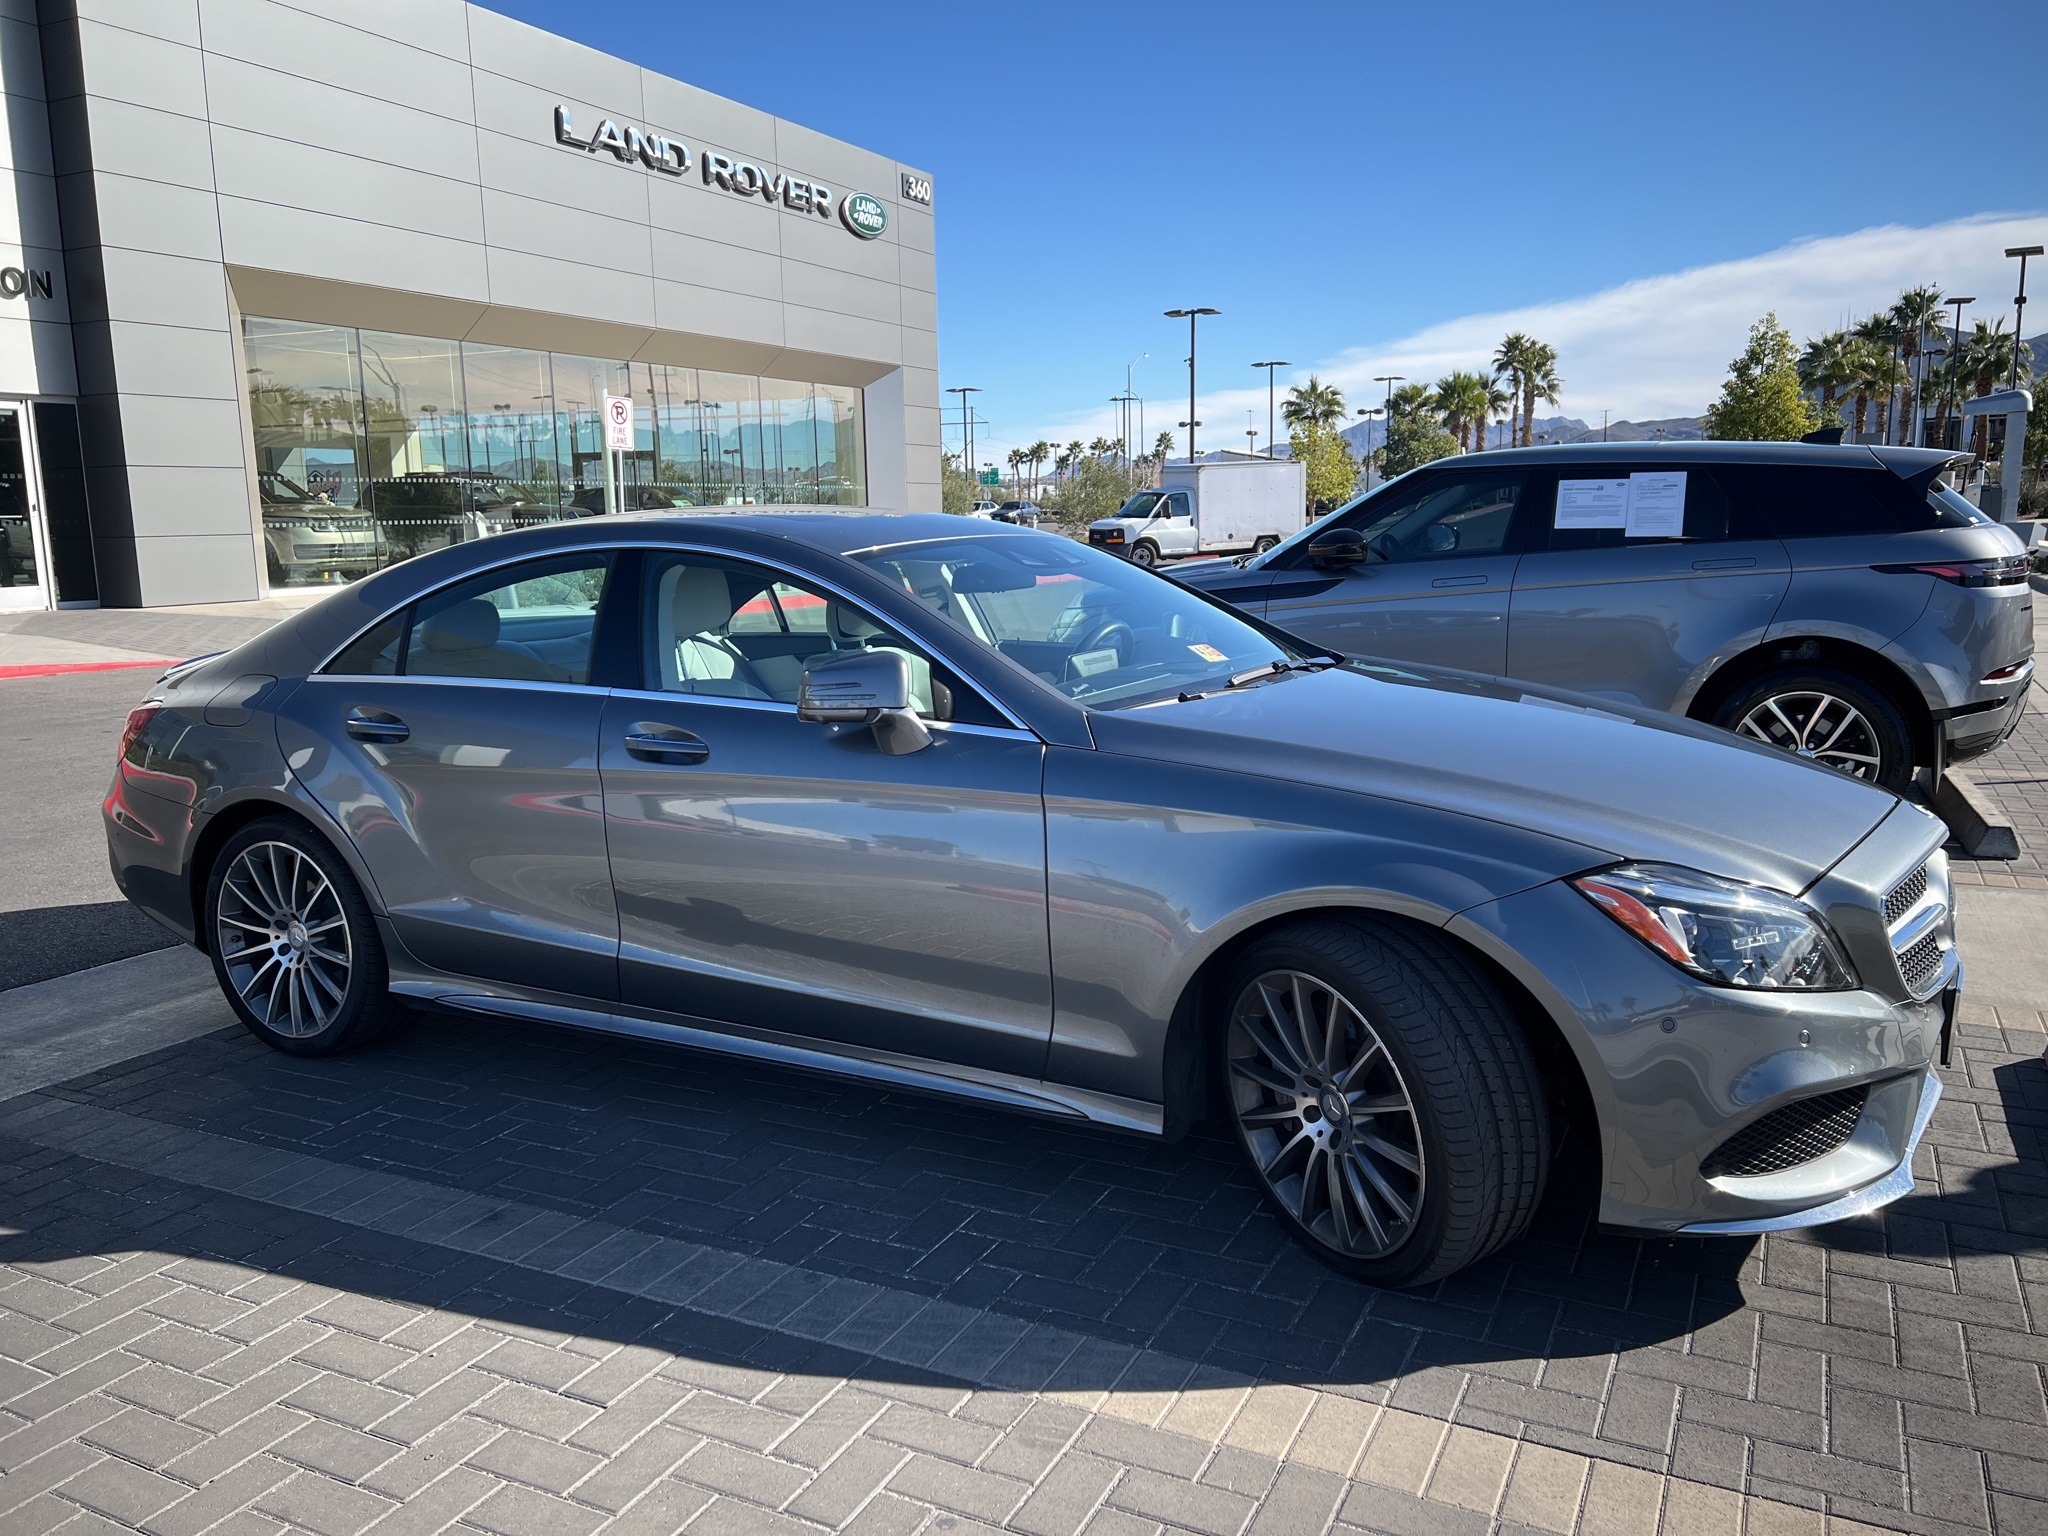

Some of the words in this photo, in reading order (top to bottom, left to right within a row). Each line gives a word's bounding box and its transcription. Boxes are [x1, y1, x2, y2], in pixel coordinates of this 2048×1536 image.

[554, 105, 692, 177] LAND
[702, 150, 833, 219] ROVER
[908, 176, 931, 201] 360
[855, 198, 878, 214] LAND
[857, 211, 883, 229] ROVER
[613, 427, 626, 436] FIRE
[612, 436, 628, 445] LANE
